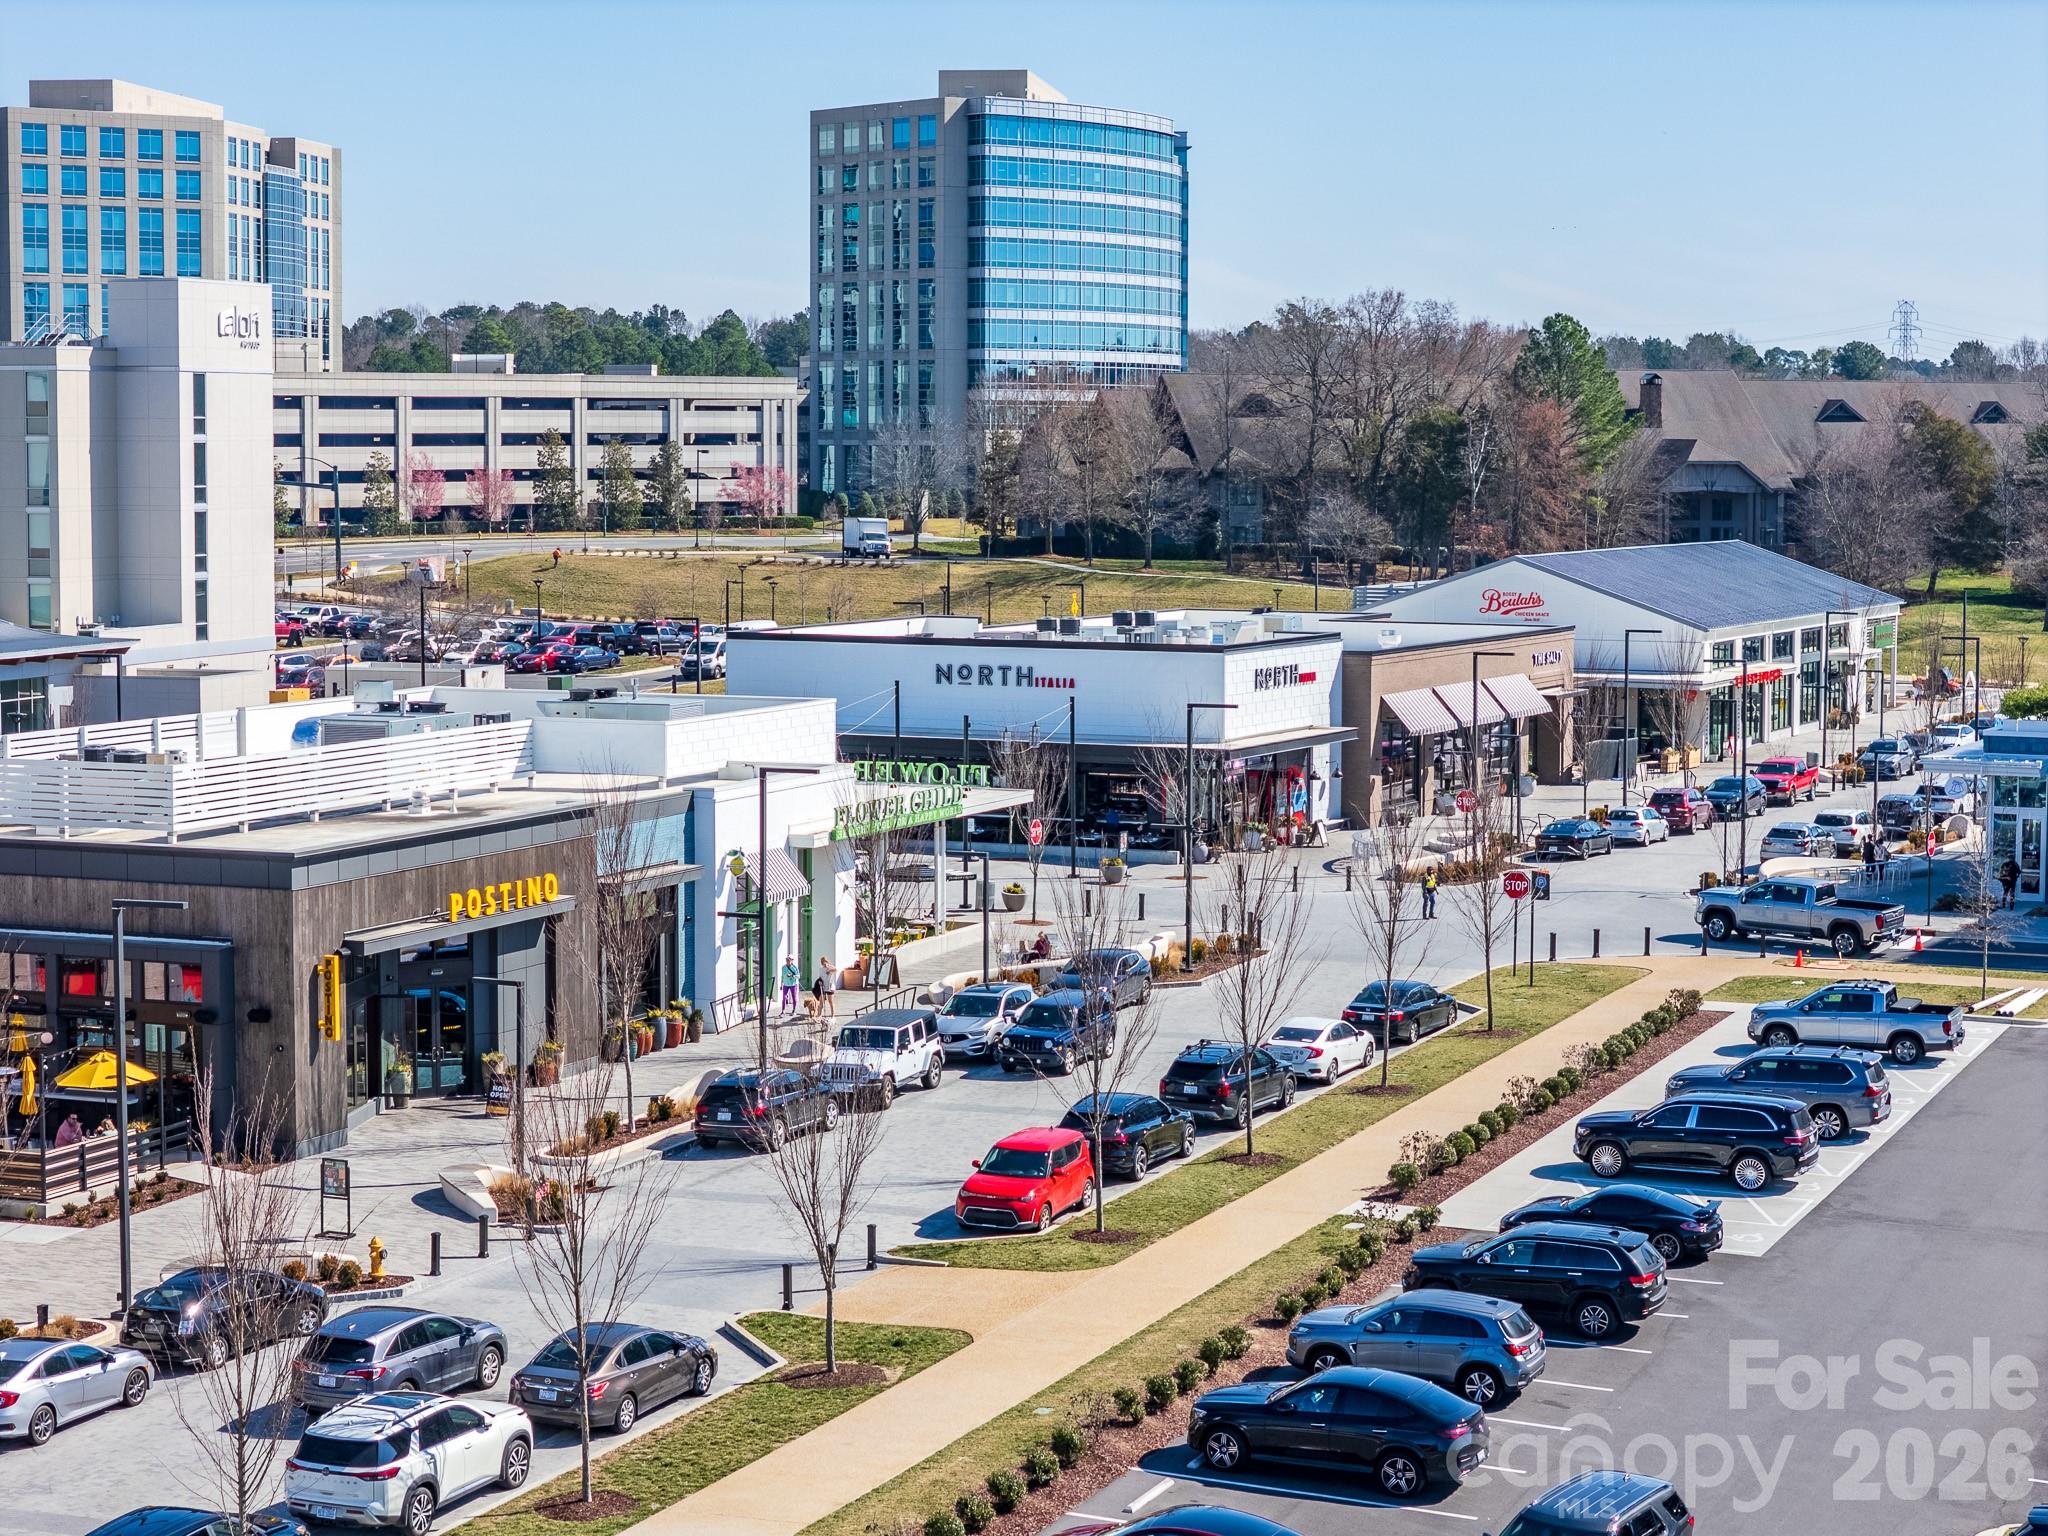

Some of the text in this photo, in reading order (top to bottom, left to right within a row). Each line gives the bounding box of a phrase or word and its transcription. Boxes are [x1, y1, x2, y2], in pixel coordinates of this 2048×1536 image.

[1479, 588, 1545, 615] Beulah's
[935, 663, 1076, 689] NORTH ITALIA
[1254, 663, 1299, 692] NORTH
[833, 784, 963, 828] FLOWER CHILD
[1457, 797, 1476, 806] STOP
[449, 872, 558, 923] POSTINO
[1505, 880, 1528, 891] STOP
[323, 958, 333, 1039] POSTINO
